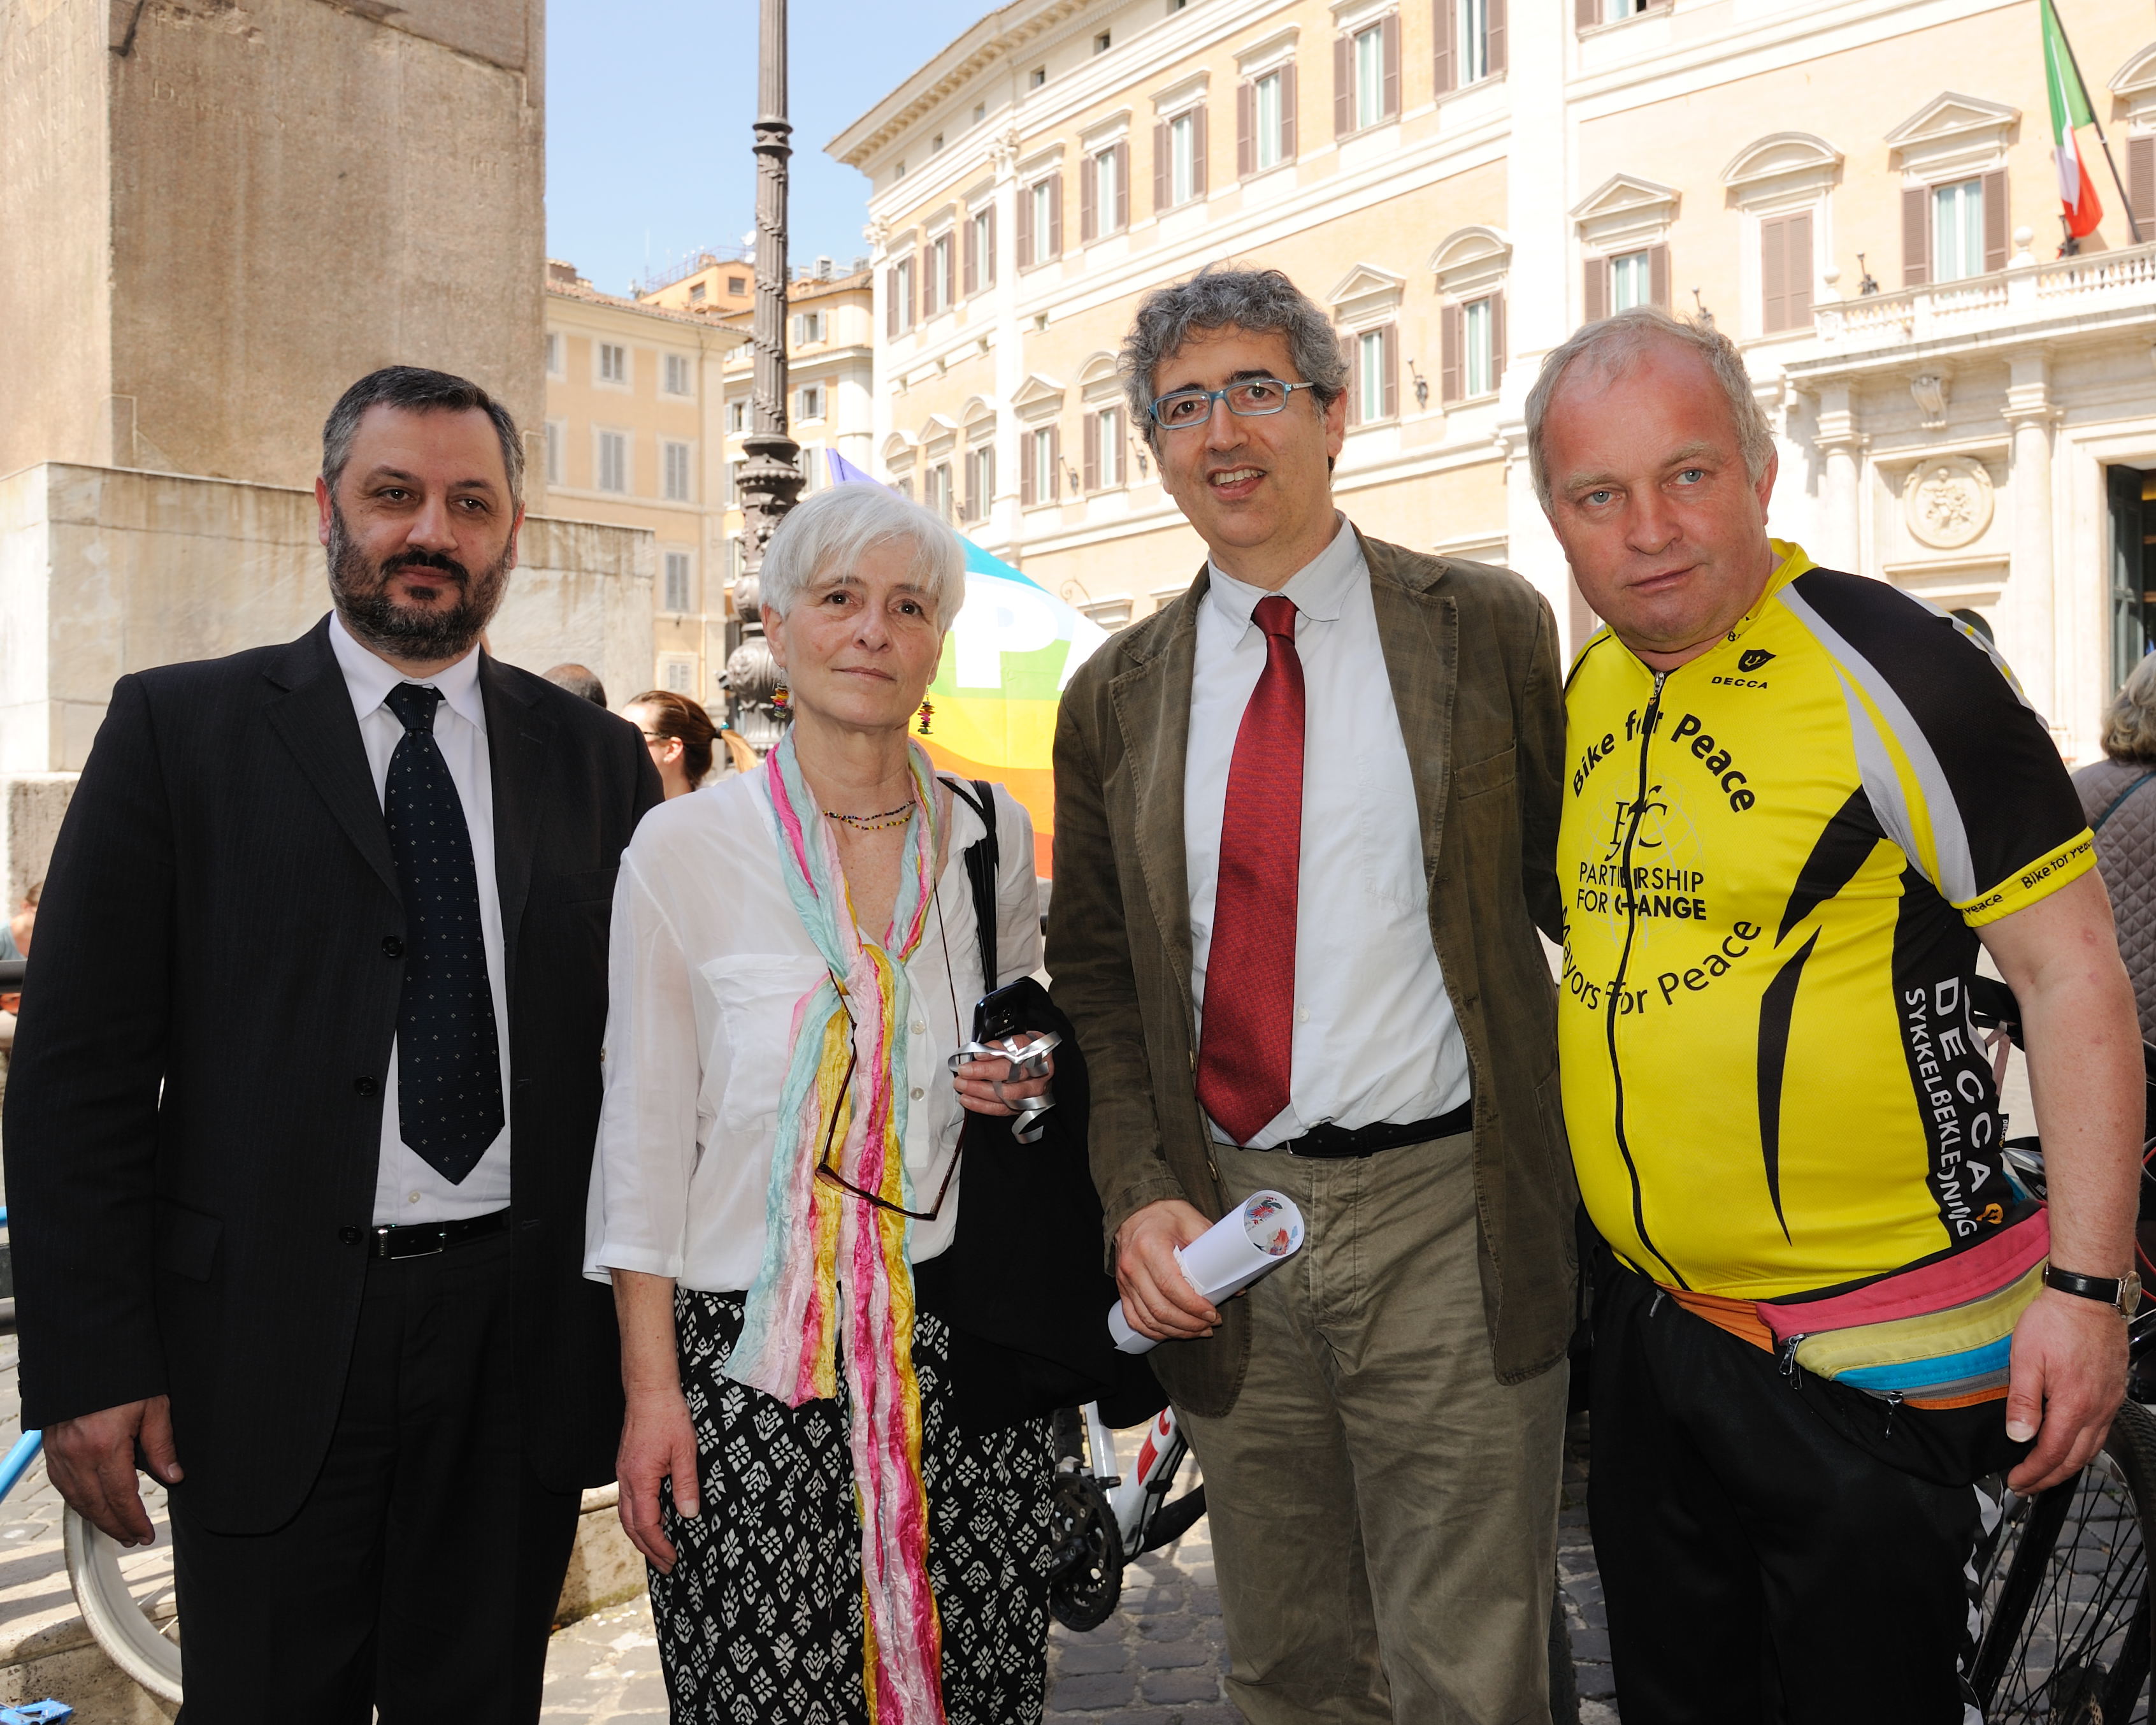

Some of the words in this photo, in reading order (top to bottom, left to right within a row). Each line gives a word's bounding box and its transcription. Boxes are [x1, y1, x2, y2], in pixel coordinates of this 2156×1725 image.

[1711, 676, 1768, 689] DECCA
[1573, 733, 1615, 798] Bike
[1671, 713, 1755, 813] Peace
[1577, 888, 1607, 914] FOR
[2021, 871, 2051, 889] Bike
[1657, 921, 1762, 1006] Peace
[1935, 976, 1992, 1194] DECCA
